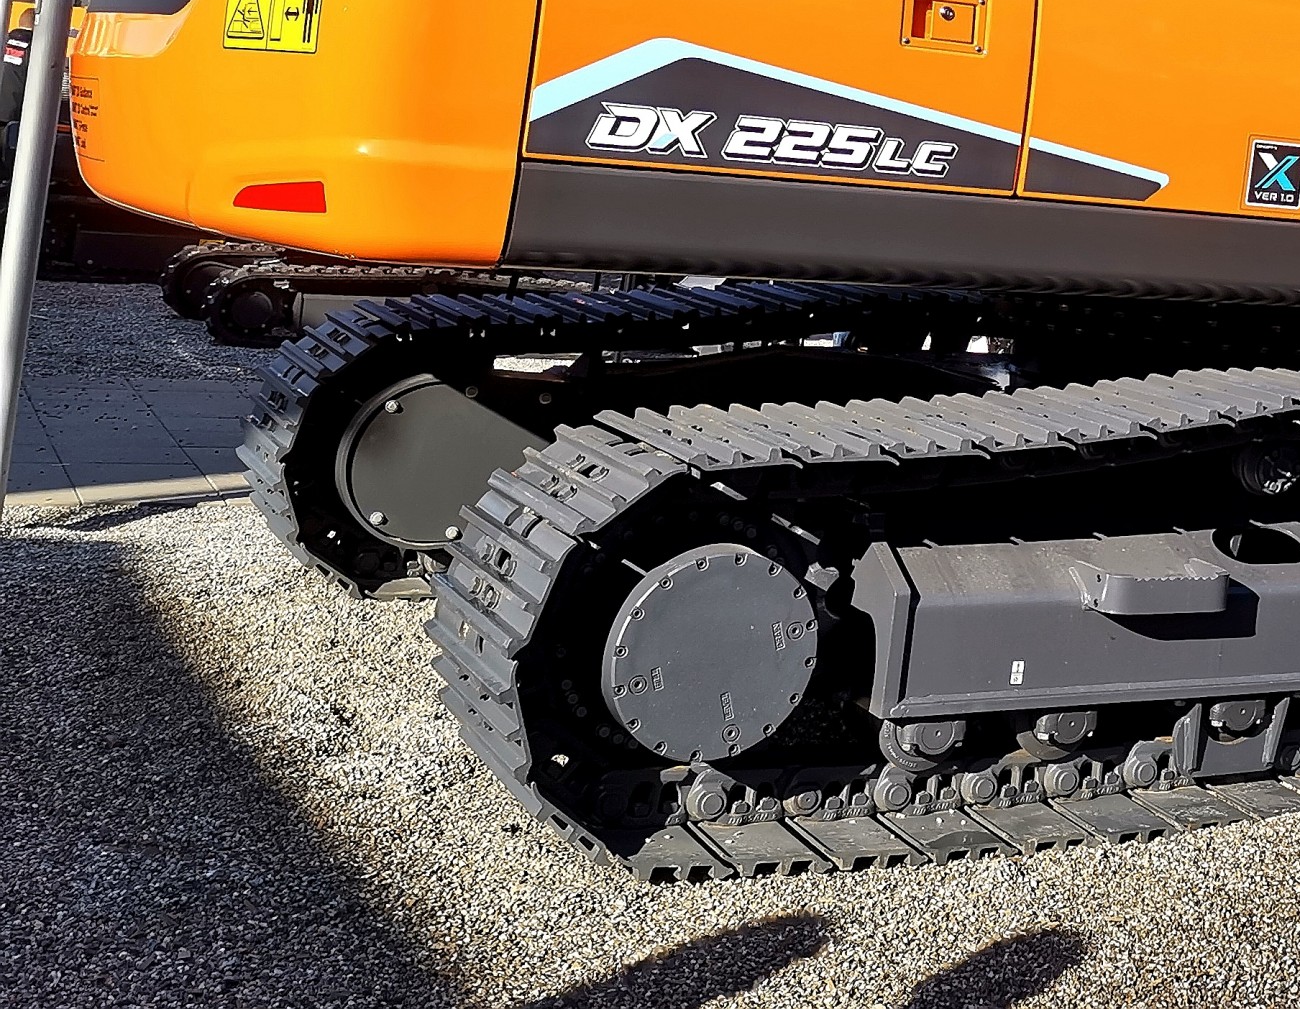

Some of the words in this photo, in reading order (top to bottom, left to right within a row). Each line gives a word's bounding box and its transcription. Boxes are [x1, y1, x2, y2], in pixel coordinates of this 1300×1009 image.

[585, 102, 717, 159] DX
[1254, 191, 1278, 202] VER
[1280, 192, 1295, 203] 1.0
